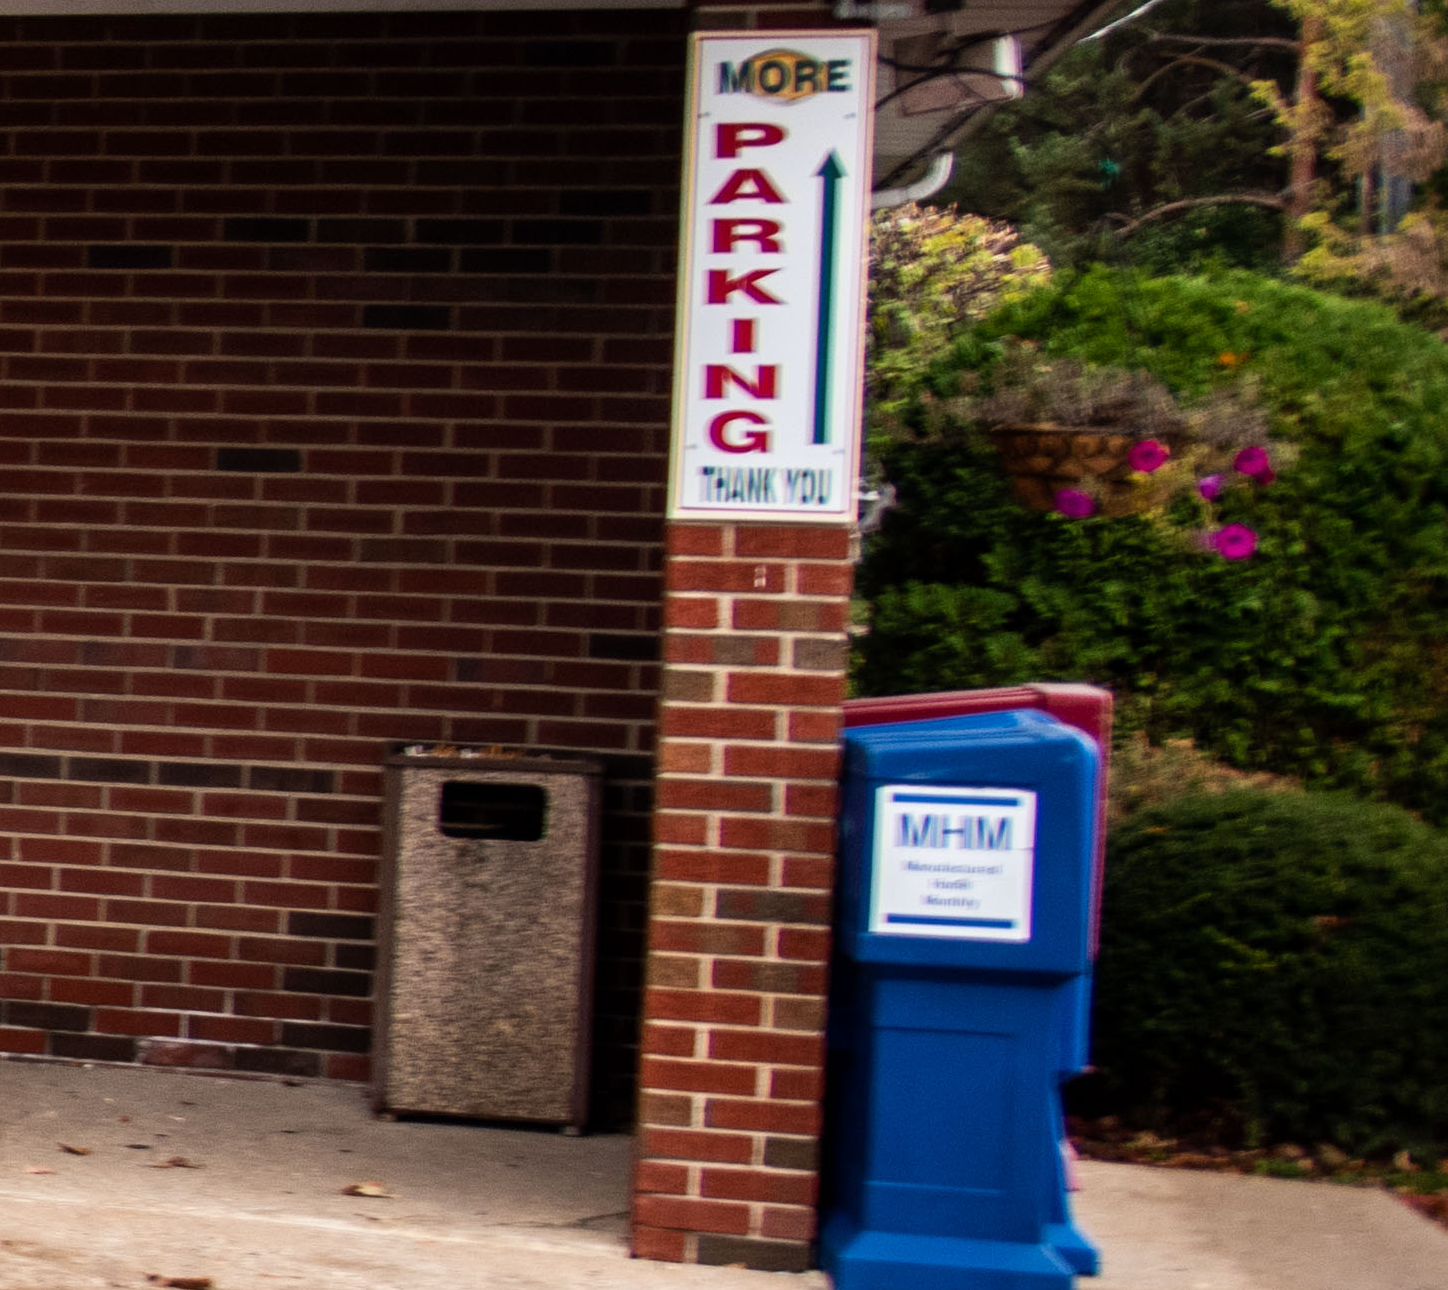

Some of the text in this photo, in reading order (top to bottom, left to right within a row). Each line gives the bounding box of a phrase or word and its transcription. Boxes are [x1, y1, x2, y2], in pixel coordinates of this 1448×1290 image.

[717, 59, 853, 95] MORE
[702, 122, 788, 455] PARKING
[699, 466, 833, 506] THANK YOU
[894, 813, 1014, 851] MHM
